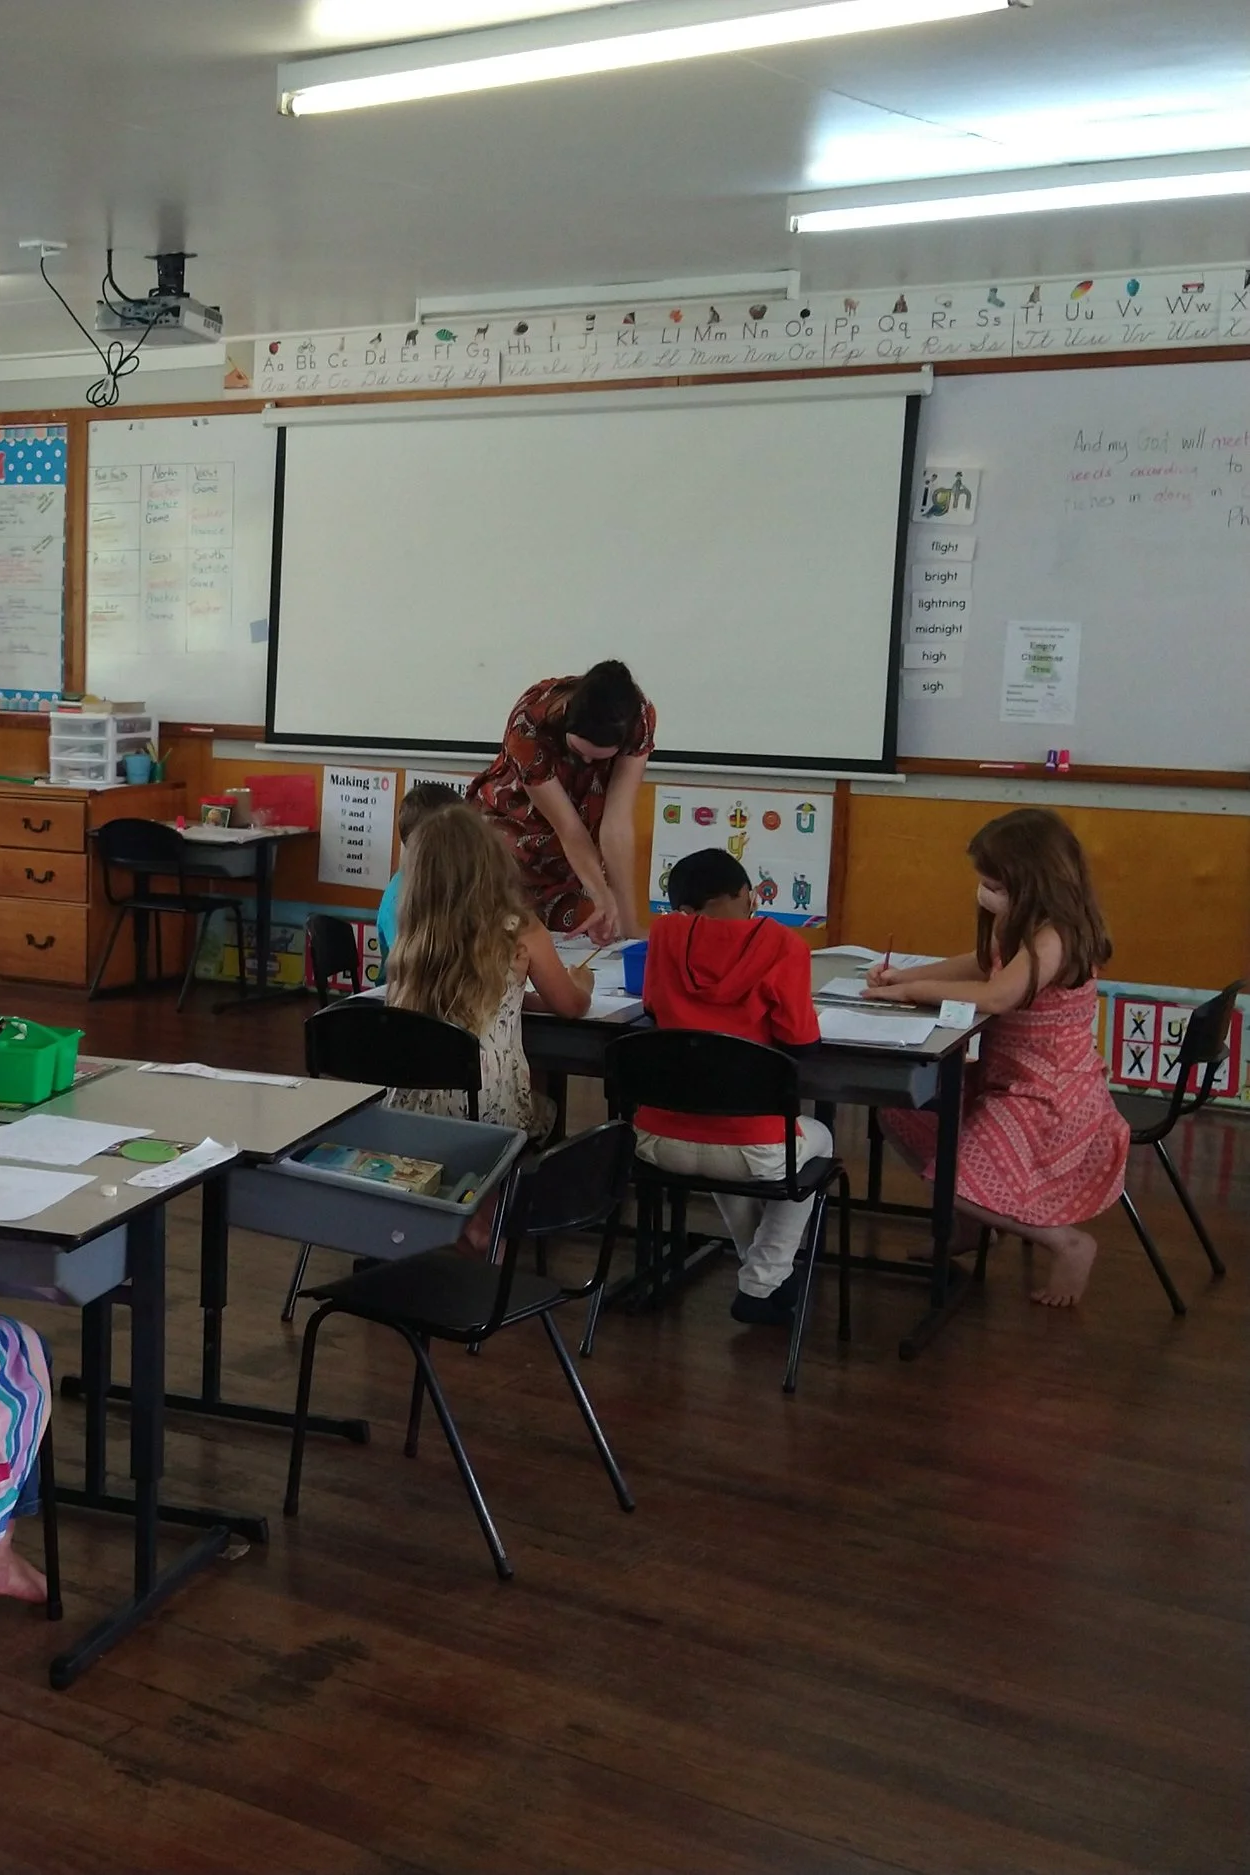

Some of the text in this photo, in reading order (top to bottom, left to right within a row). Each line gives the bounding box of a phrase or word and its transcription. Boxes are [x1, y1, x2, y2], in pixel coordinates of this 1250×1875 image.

[262, 358, 284, 372] Aa
[296, 355, 316, 370] Bb
[327, 352, 348, 369] Cc
[364, 348, 387, 366] Dd
[466, 342, 490, 364] Gg
[507, 338, 531, 355] Hh
[578, 332, 598, 356] Jj
[616, 324, 639, 347] Kk
[660, 327, 680, 344] Ll
[694, 325, 727, 342] Mm
[742, 322, 769, 340] Nn
[785, 320, 813, 337] Oo
[834, 317, 860, 342] Pp
[878, 314, 911, 339] Qq
[931, 311, 957, 329] Rr
[976, 309, 1001, 327] Ss
[1020, 303, 1044, 324] Tt
[1065, 303, 1094, 321] Uu
[1116, 298, 1143, 318] Vv
[1166, 294, 1212, 314] Ww
[1073, 428, 1103, 452] And
[1108, 439, 1128, 464] my
[1181, 426, 1207, 451] will
[1225, 453, 1243, 475] to
[931, 540, 958, 554] flight
[925, 571, 958, 585] bright
[918, 599, 966, 612] lightning
[915, 624, 963, 637] midnight
[922, 650, 947, 663] high
[922, 681, 944, 693] sigh
[330, 774, 390, 791] Making 10
[340, 794, 350, 802] 10
[694, 806, 714, 826] e
